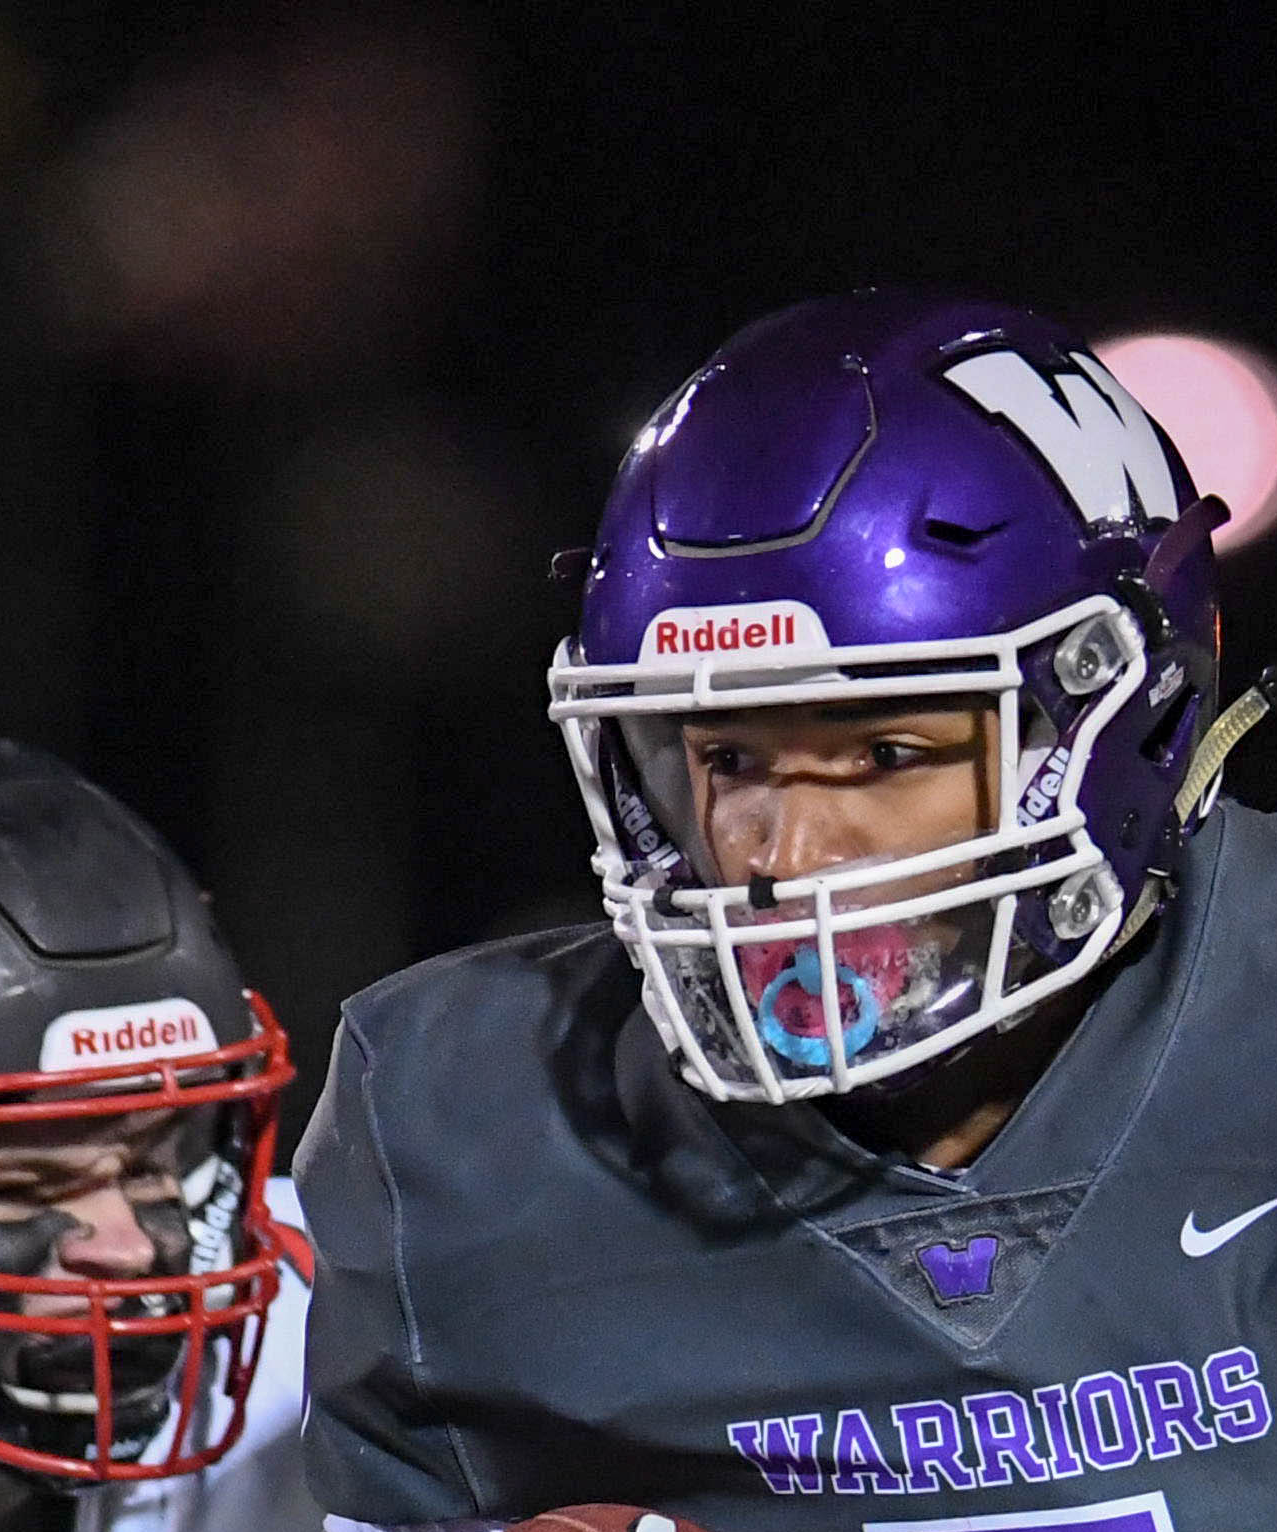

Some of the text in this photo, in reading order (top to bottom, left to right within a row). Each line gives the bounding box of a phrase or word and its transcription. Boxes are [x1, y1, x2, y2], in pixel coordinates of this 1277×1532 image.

[941, 350, 1180, 524] W
[655, 611, 796, 656] Riddell
[71, 1013, 200, 1057] Riddell
[915, 1234, 1000, 1308] W
[726, 1345, 1275, 1498] WARRIORS
